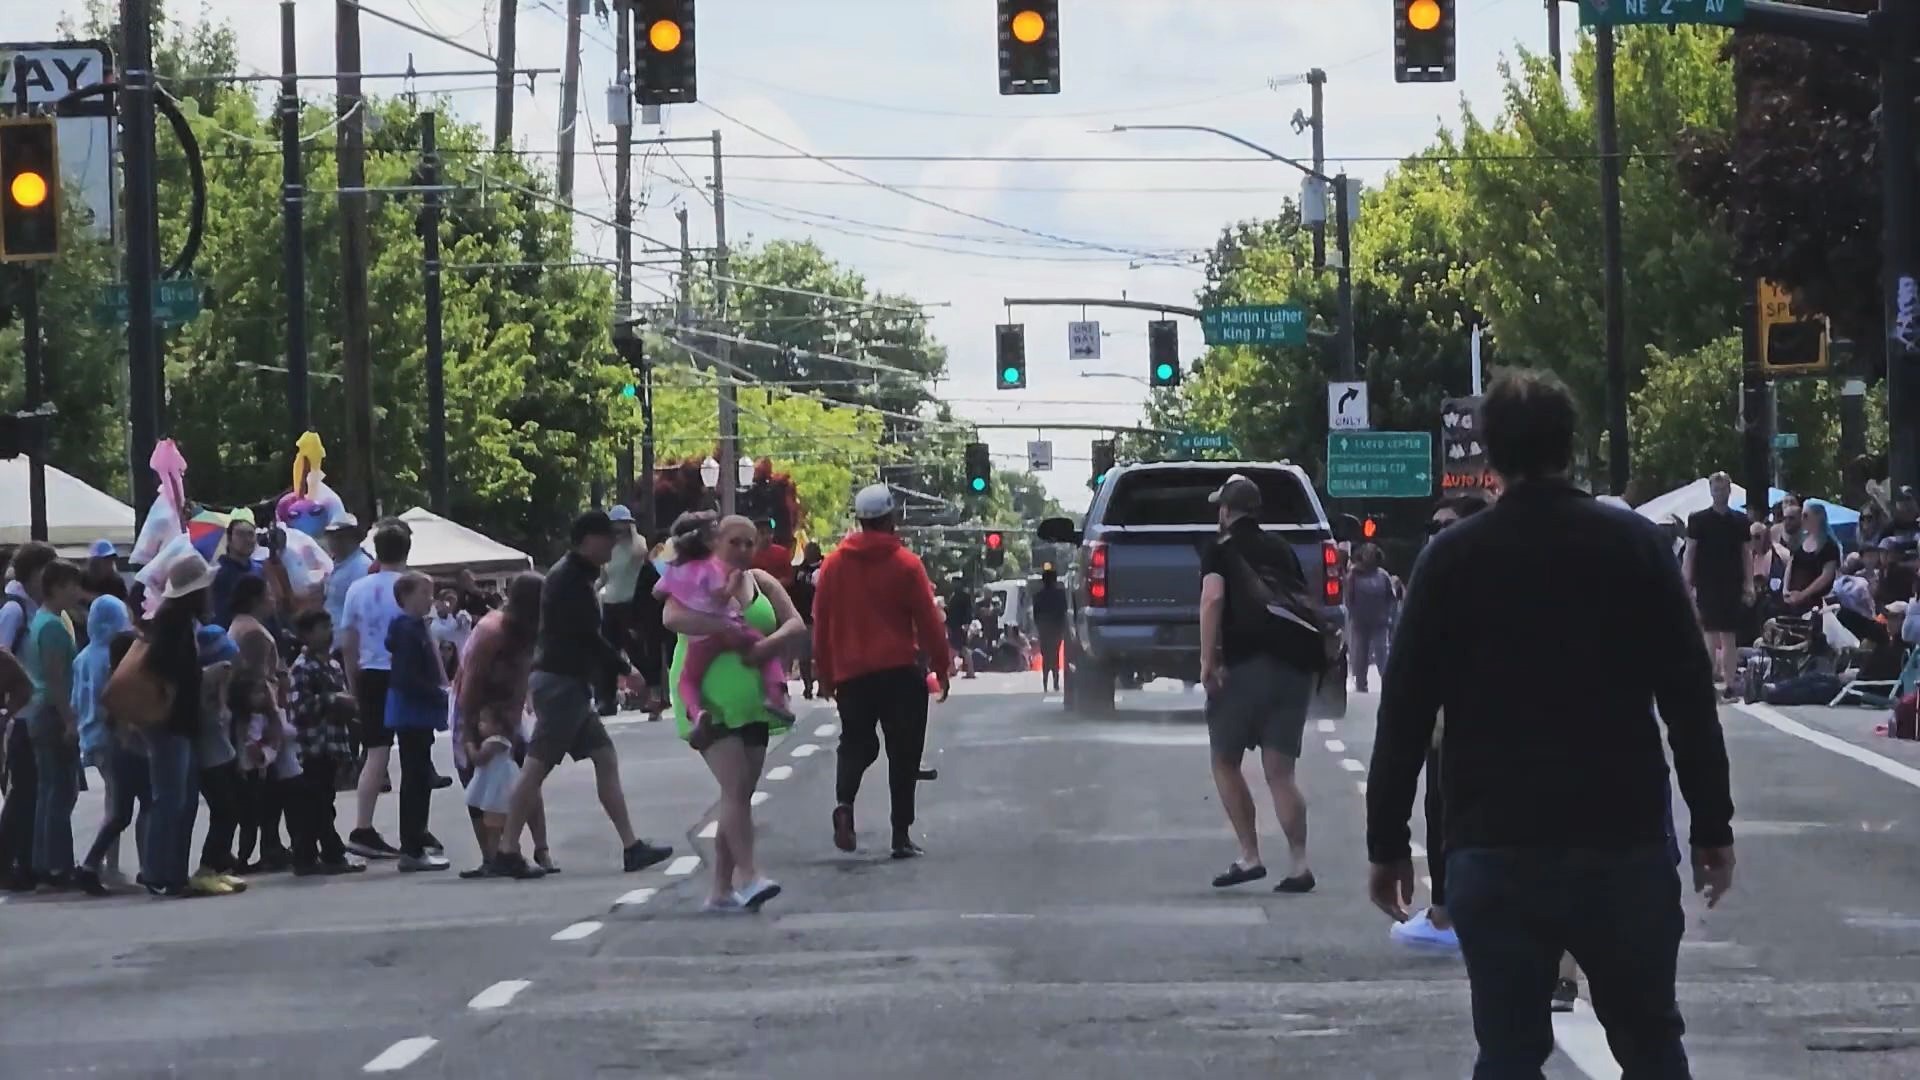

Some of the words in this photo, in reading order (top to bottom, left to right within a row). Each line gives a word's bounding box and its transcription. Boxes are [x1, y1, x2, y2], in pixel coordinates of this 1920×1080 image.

[1625, 0, 1648, 15] NE
[1705, 0, 1725, 13] AV
[0, 57, 91, 92] AY
[1221, 311, 1260, 324] Martin
[1263, 309, 1303, 324] Luther
[1223, 326, 1251, 341] King
[1256, 327, 1266, 340] Jr
[1335, 416, 1361, 426] ONLY
[1193, 435, 1221, 447] Grand
